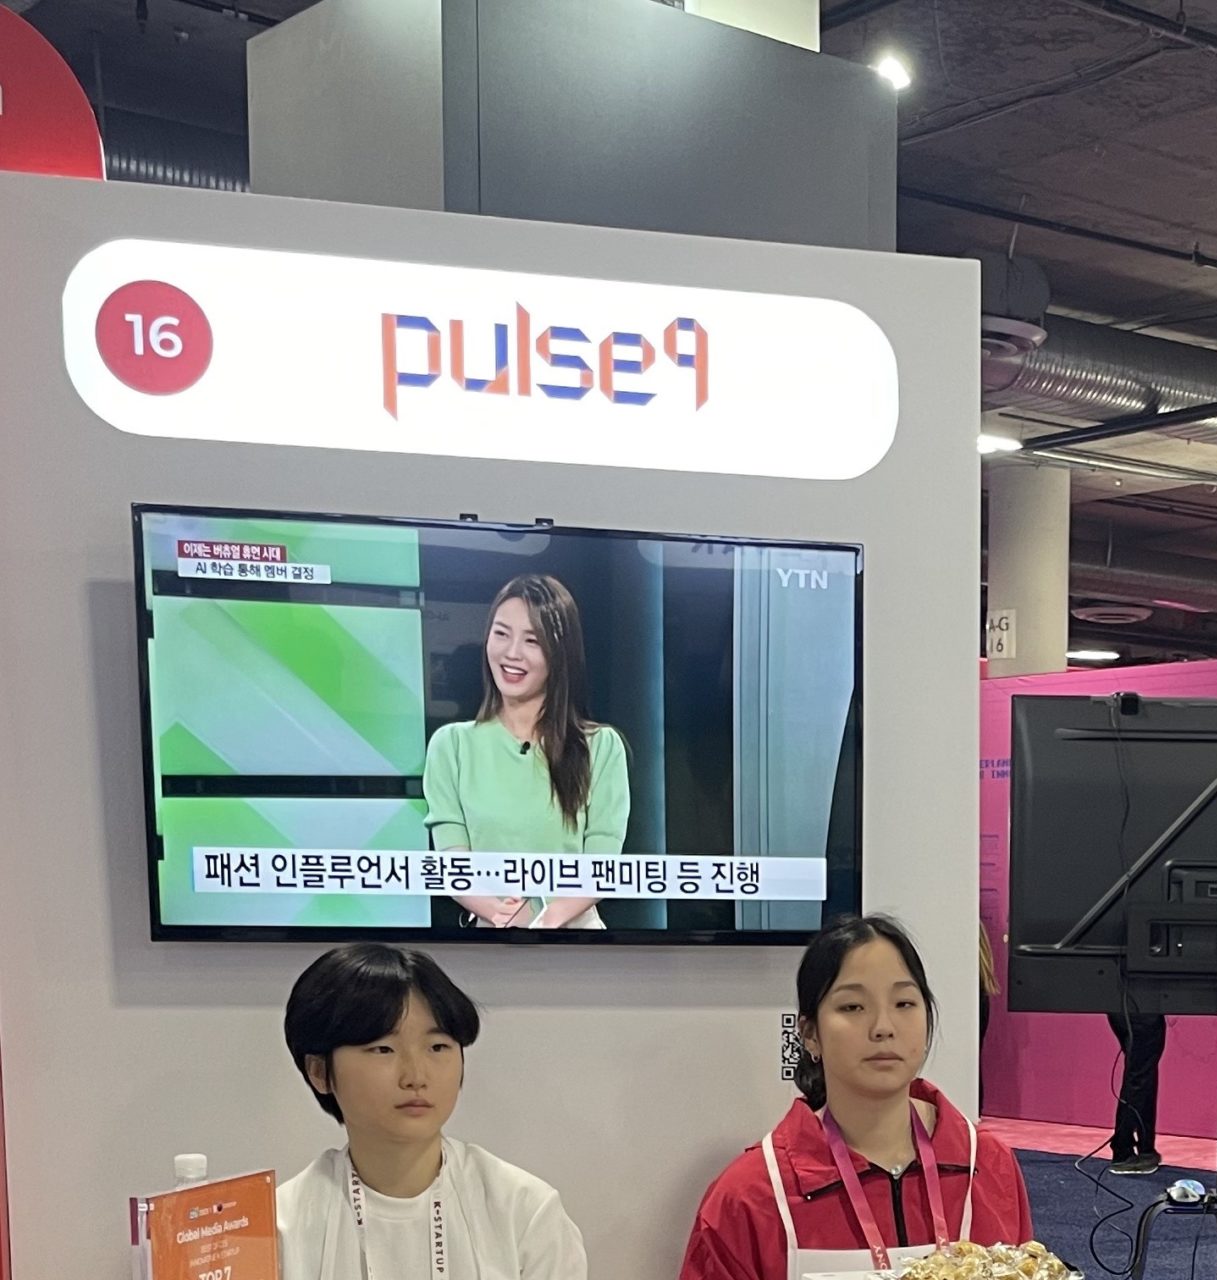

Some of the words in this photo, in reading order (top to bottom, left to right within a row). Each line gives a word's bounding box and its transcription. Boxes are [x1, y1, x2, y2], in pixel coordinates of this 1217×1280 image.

[124, 313, 183, 358] 16
[380, 301, 710, 422] pulse9
[195, 562, 207, 574] AI
[210, 563, 234, 577] 학습
[776, 567, 828, 590] YTN
[205, 853, 262, 888] 패션
[271, 853, 411, 890] 인플루언서
[591, 859, 667, 894] 팬미팅
[677, 861, 703, 894] 등
[710, 861, 760, 895] 진행
